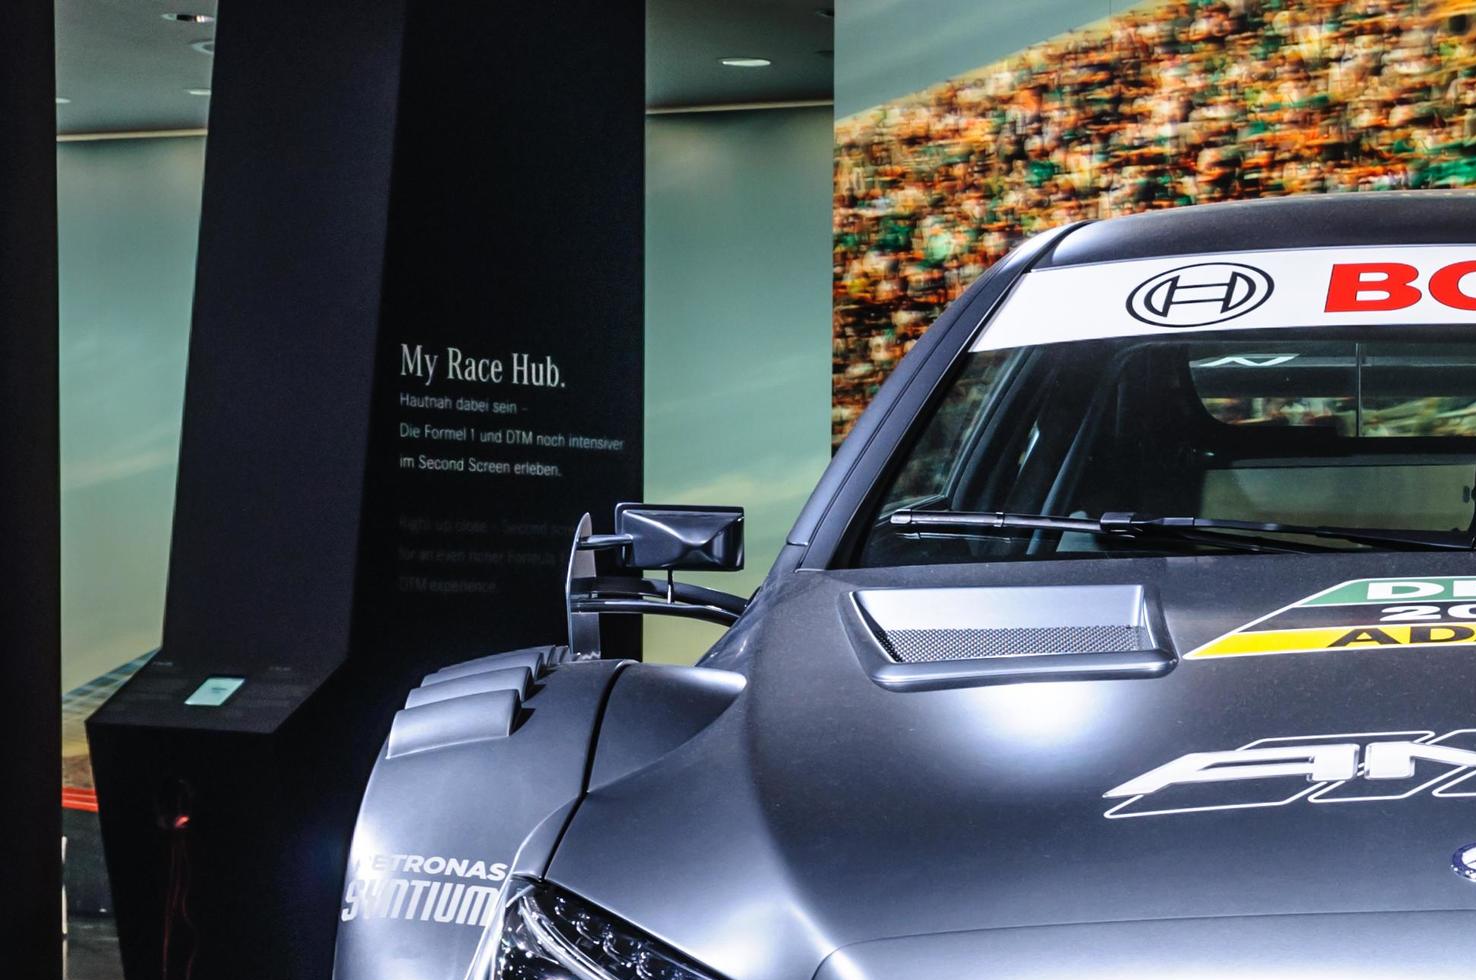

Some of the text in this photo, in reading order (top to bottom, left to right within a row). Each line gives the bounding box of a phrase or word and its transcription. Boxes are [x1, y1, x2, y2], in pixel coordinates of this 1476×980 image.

[400, 343, 567, 388] My Race Hub.
[400, 393, 452, 410] Hautnah
[456, 396, 489, 412] dabei
[492, 400, 518, 414] sein
[400, 422, 625, 450] Die Formel 1 und DTM noch intensiver
[400, 455, 562, 477] im Second Screen erleben.
